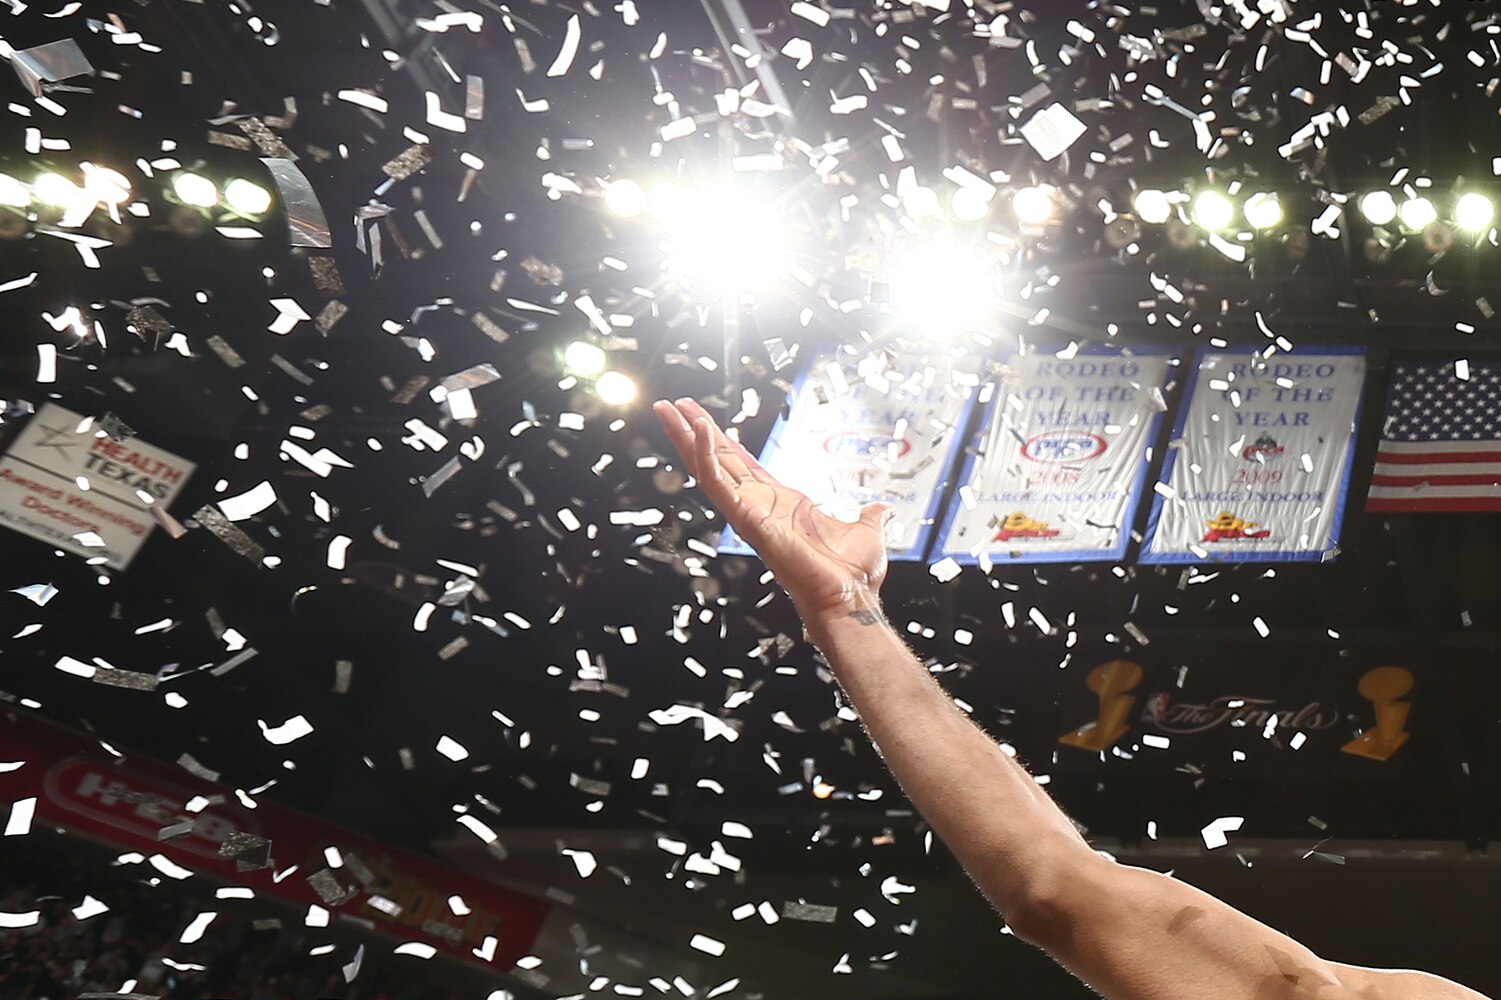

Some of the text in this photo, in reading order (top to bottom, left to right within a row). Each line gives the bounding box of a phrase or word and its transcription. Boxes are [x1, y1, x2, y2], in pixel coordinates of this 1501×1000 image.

[1036, 362, 1140, 379] RODEO
[1231, 363, 1336, 379] RODEO
[1025, 386, 1136, 402] OF THE
[1271, 387, 1336, 403] THE
[1034, 411, 1112, 426] YEAR
[1233, 411, 1311, 427] YEAR
[91, 438, 184, 484] HEALTH
[84, 451, 172, 500] TEXAS
[1231, 468, 1284, 484] 2009
[1182, 491, 1326, 504] LARGE INDOOR
